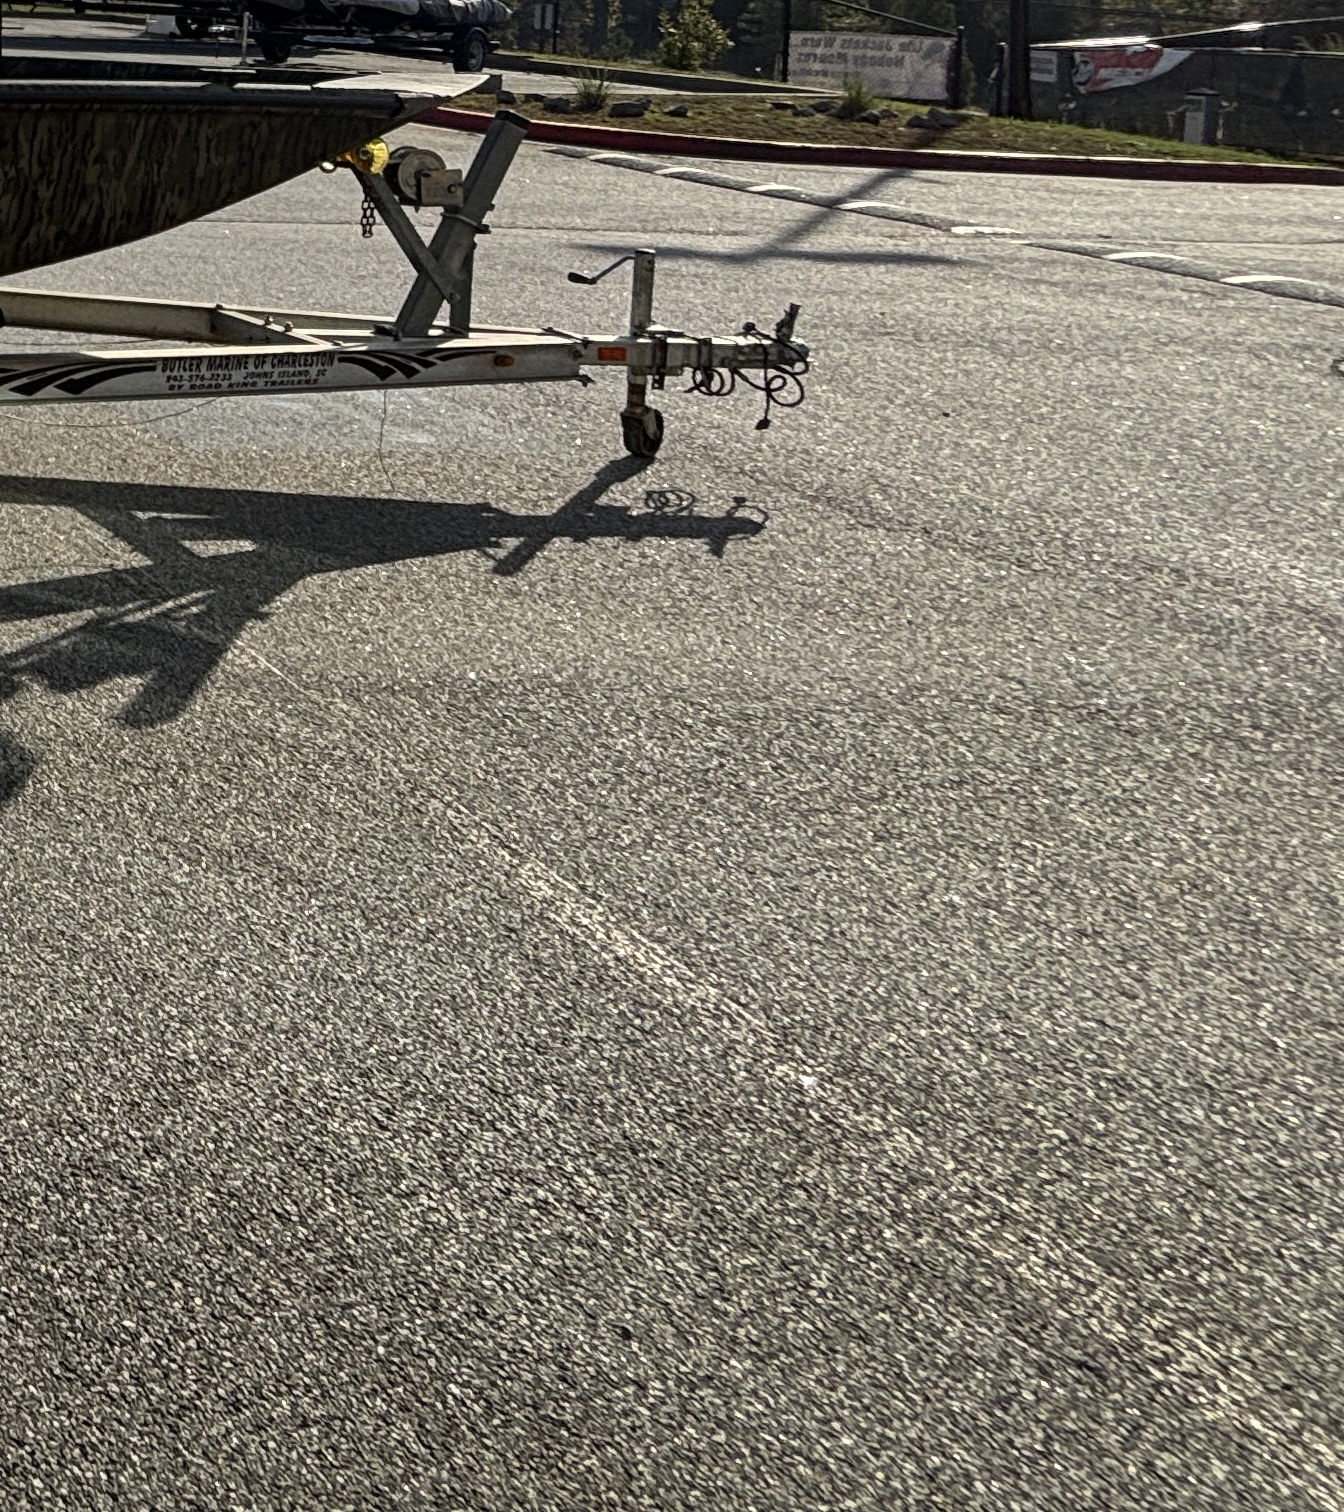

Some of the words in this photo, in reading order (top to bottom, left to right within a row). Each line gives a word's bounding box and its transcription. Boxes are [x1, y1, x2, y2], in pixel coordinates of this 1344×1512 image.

[161, 357, 203, 374] BUTLER
[206, 355, 249, 372] MARINE
[253, 355, 267, 370] OF
[270, 352, 336, 369] CHARLESTON
[243, 371, 275, 381] JOHNS
[315, 368, 328, 377] SC
[188, 382, 222, 391] ROAD
[227, 380, 258, 389] KING
[264, 378, 319, 388] TRAILERS
